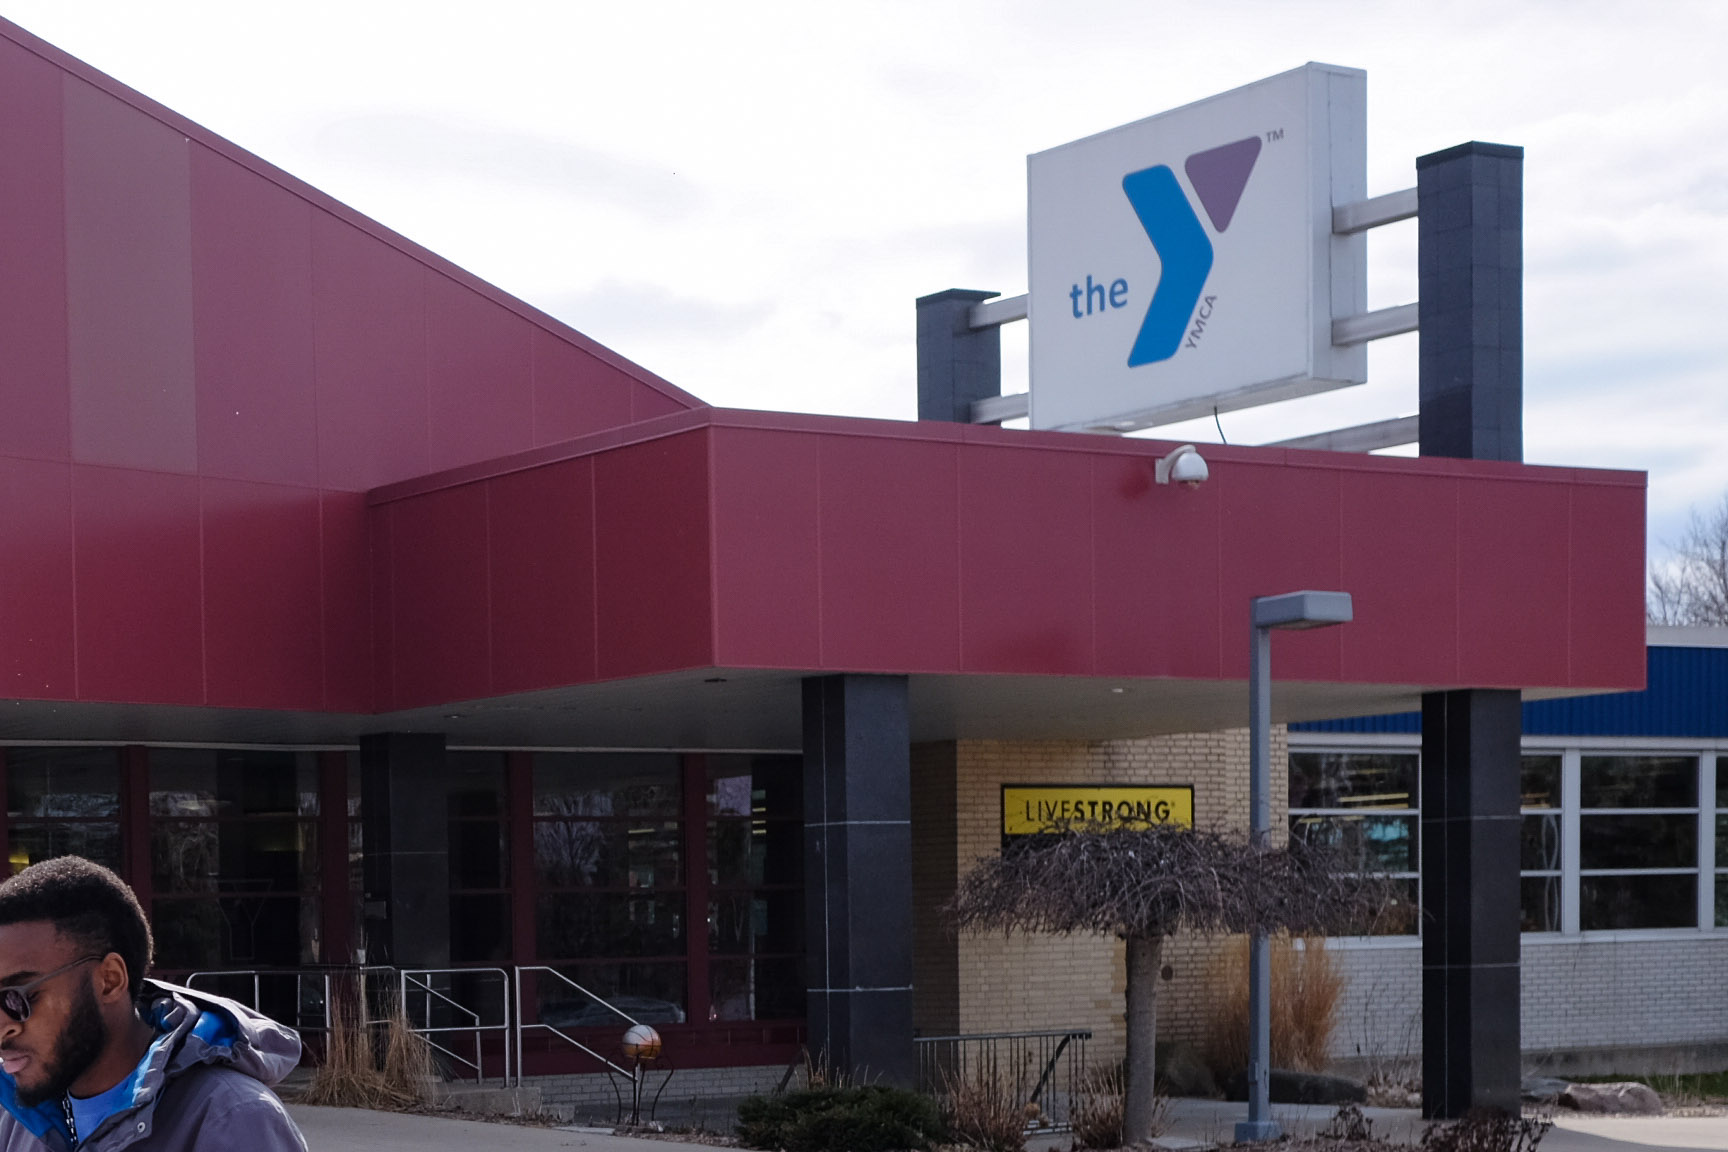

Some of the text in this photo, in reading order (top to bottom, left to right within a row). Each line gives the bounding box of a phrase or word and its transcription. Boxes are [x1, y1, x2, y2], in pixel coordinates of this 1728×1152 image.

[1069, 274, 1129, 319] the
[1184, 295, 1218, 349] YMCA
[1025, 800, 1171, 822] LIVESTRONG
